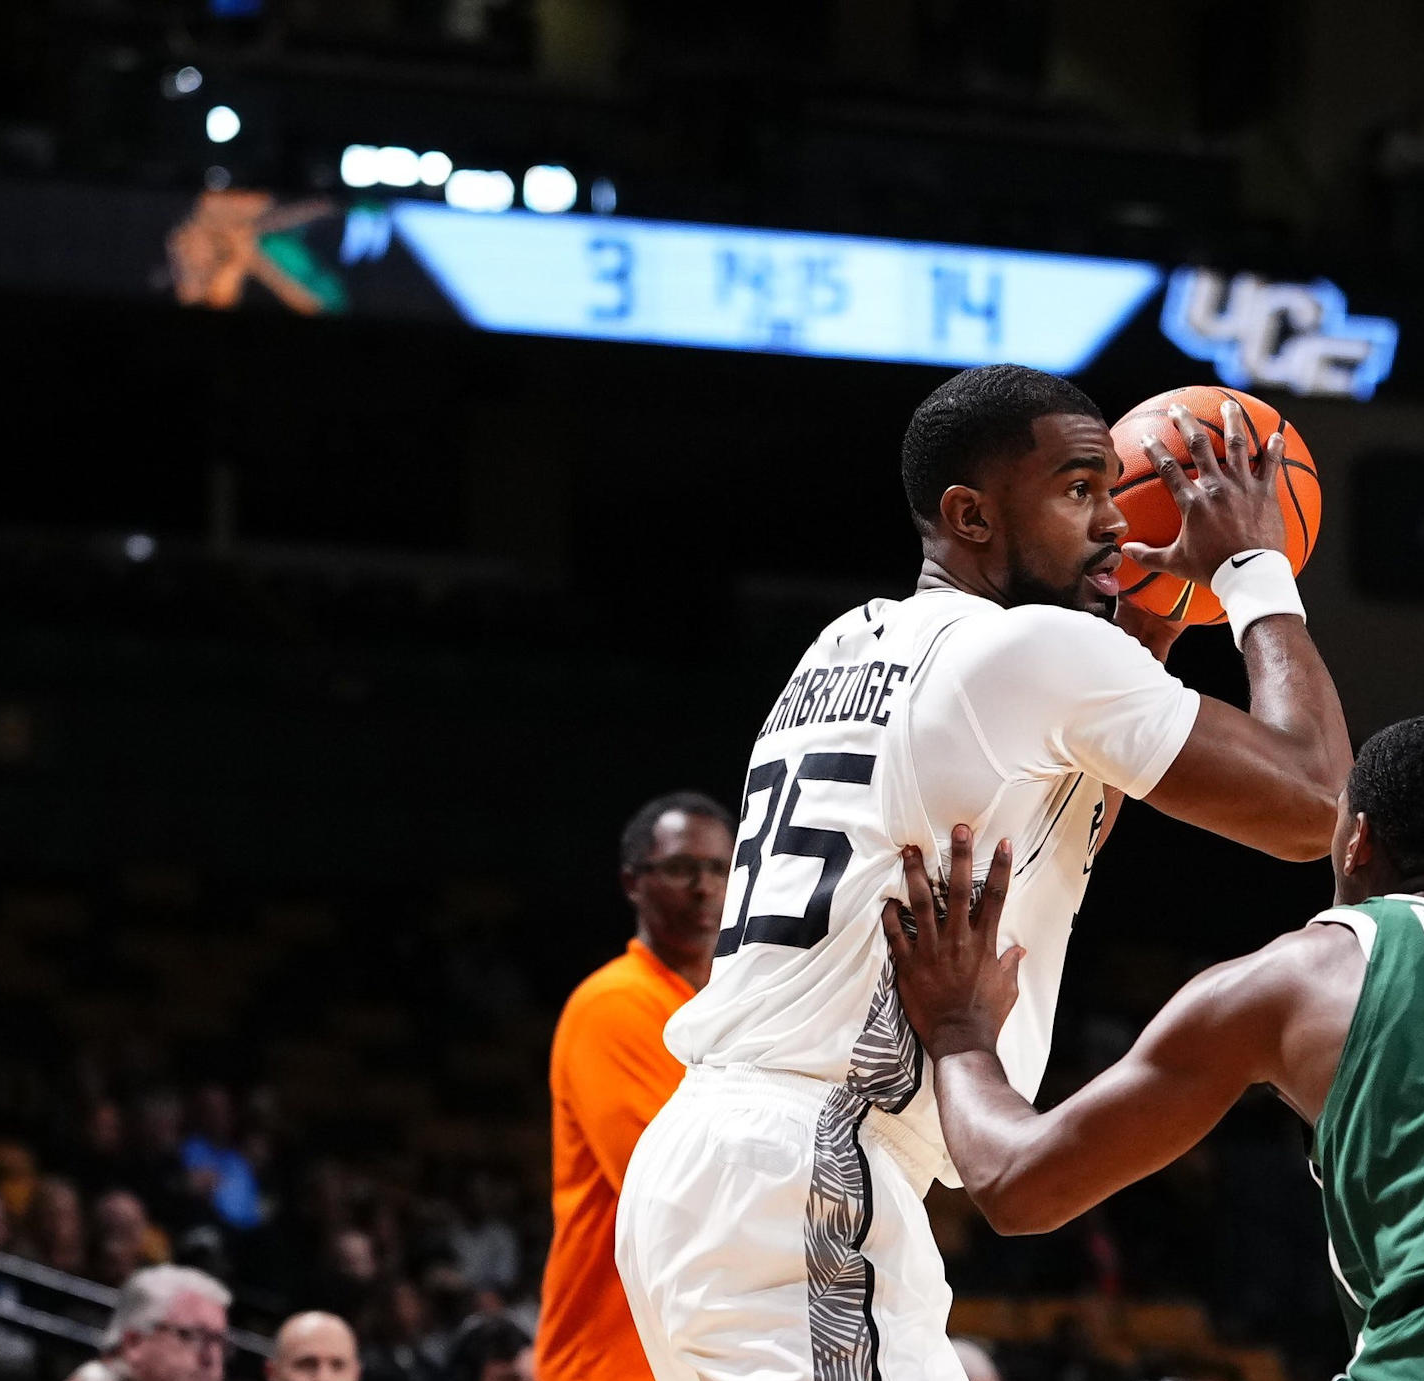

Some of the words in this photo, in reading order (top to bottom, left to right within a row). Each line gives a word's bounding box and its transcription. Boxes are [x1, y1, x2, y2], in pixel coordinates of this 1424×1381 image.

[586, 238, 633, 321] 3
[930, 265, 1004, 347] 14
[756, 660, 909, 741] AMBRIDGE
[714, 751, 877, 957] 35
